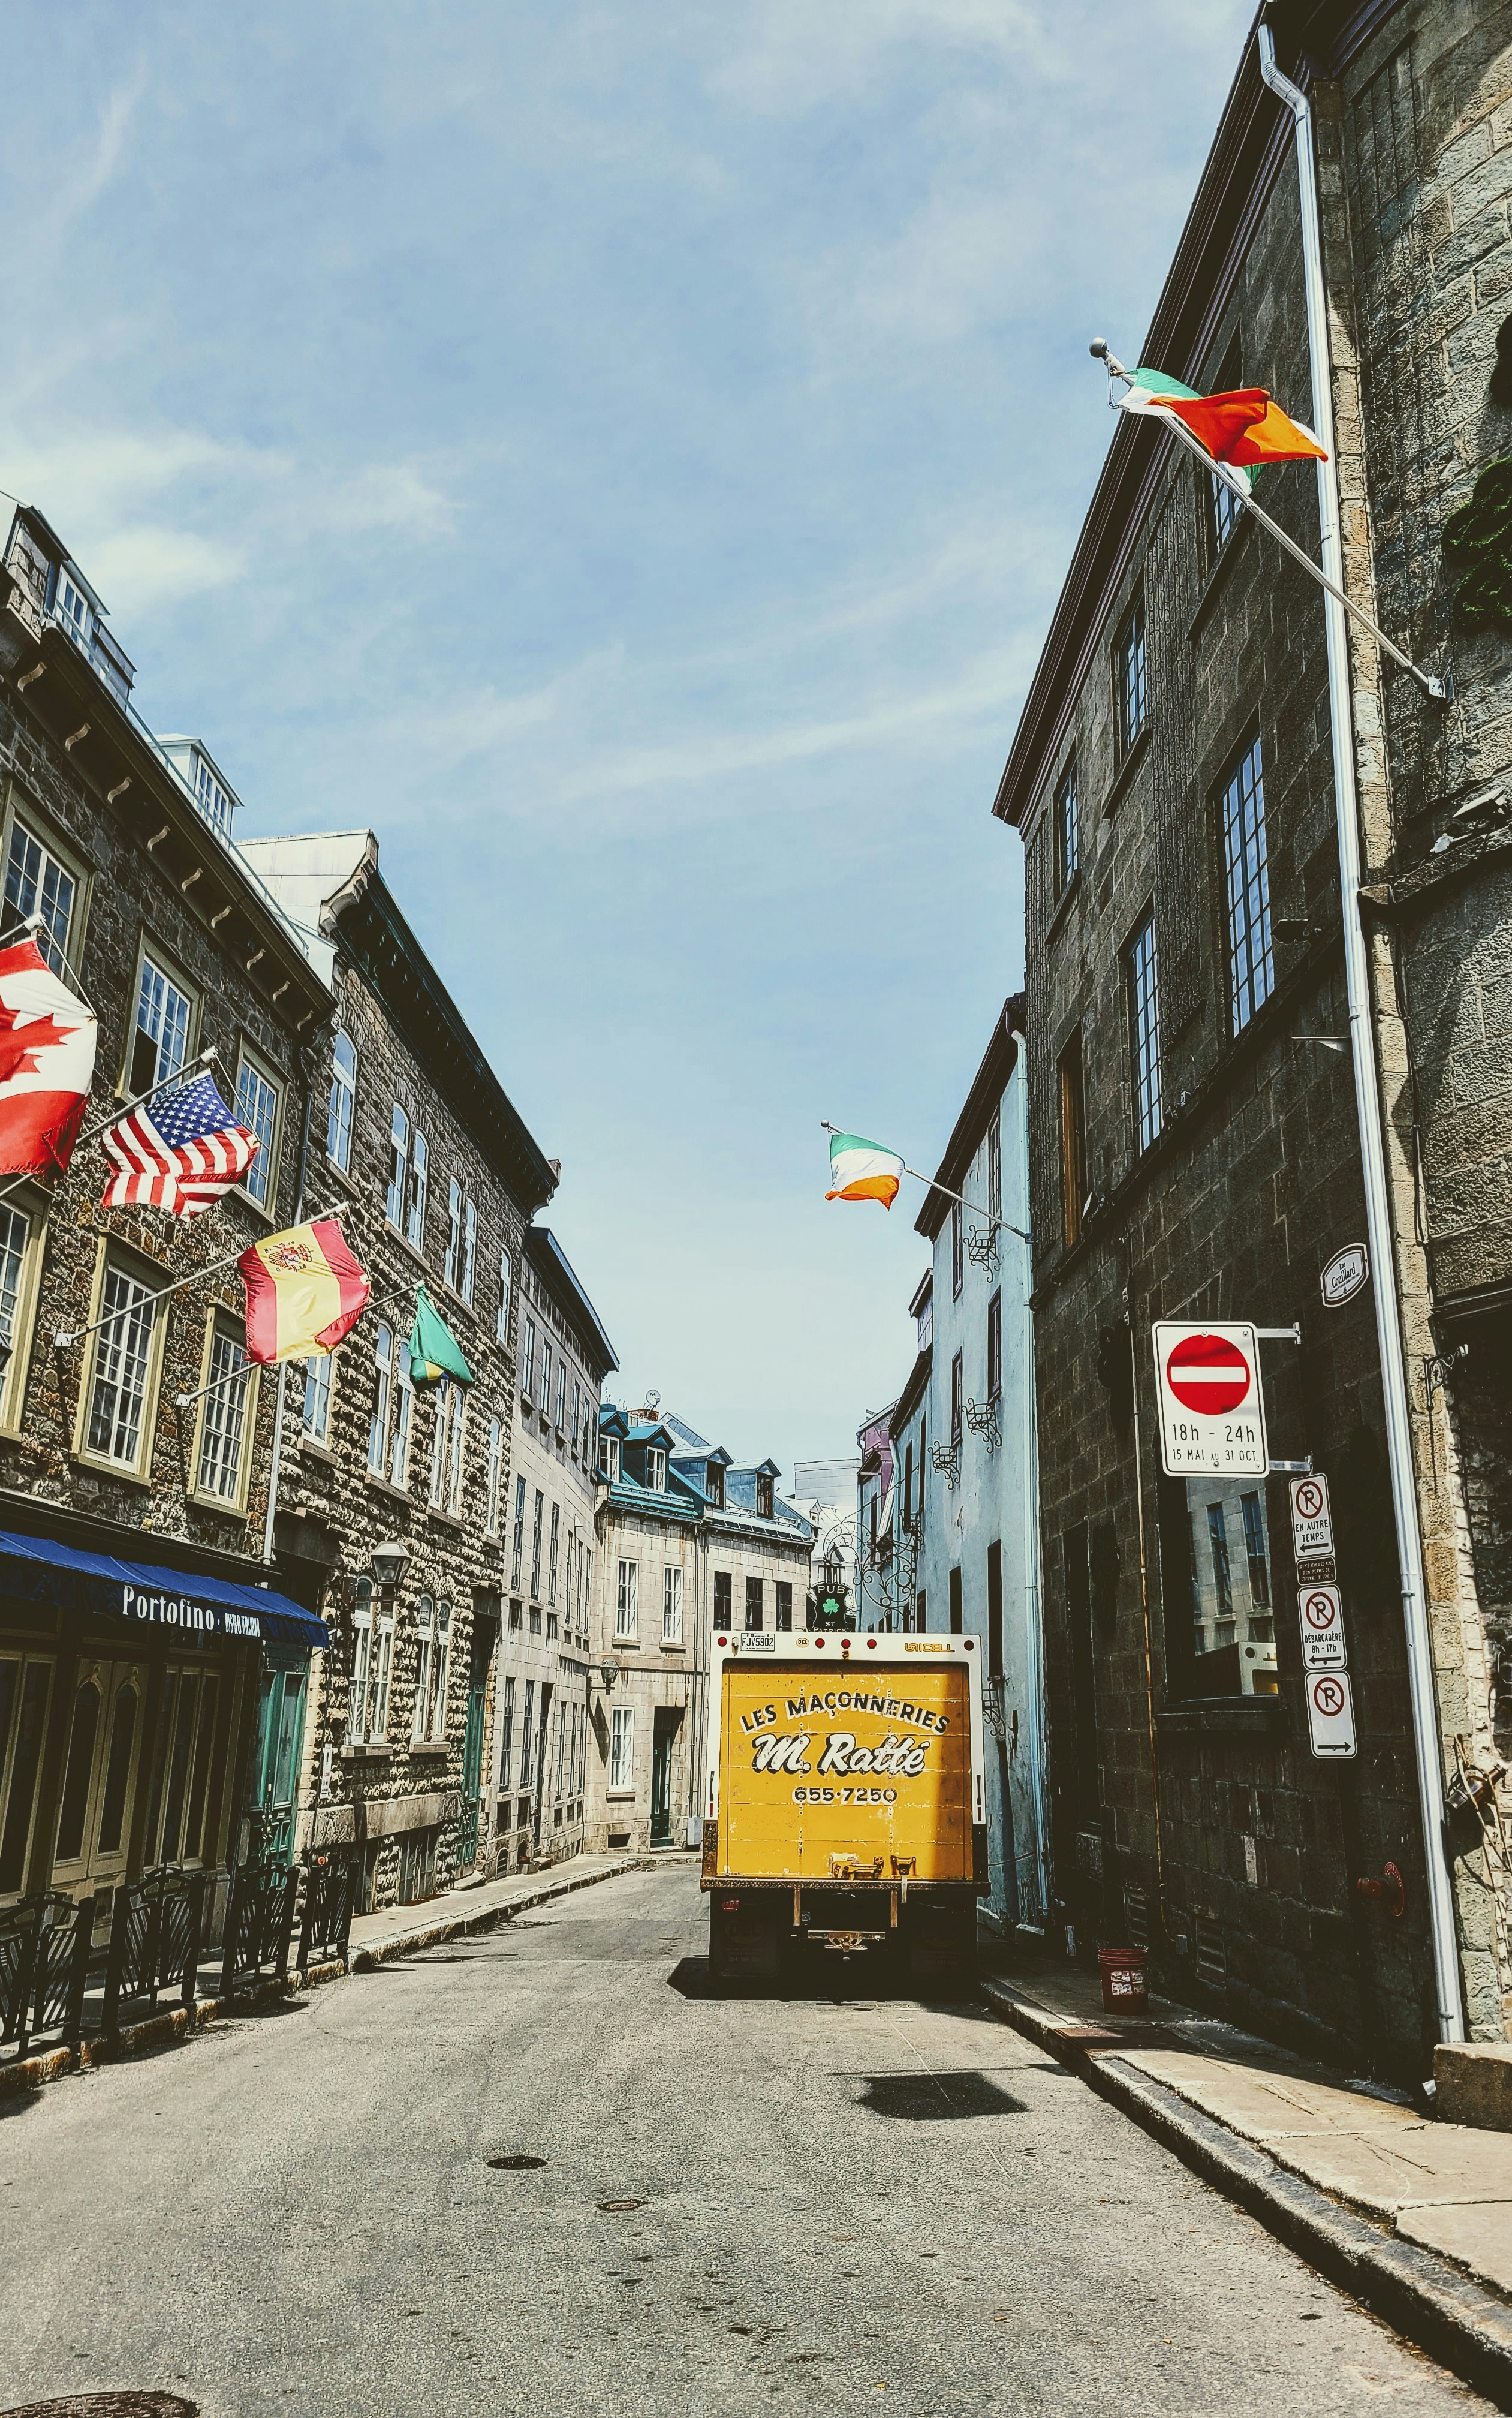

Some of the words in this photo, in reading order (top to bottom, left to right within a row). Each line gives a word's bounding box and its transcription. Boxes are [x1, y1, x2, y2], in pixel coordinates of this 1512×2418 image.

[1332, 1262, 1356, 1288] Couillard
[1172, 1424, 1199, 1441] 18h
[1225, 1425, 1255, 1442] 24h
[1173, 1449, 1182, 1460] 15
[1188, 1449, 1204, 1460] MAI
[1211, 1452, 1219, 1461] AU
[1225, 1449, 1234, 1461] 31
[1295, 1523, 1304, 1532] EN
[1306, 1519, 1329, 1530] AUTRE
[1302, 1532, 1324, 1542] TEMPS
[817, 1585, 845, 1594] PUB
[122, 1584, 215, 1631] Portofino
[742, 1637, 773, 1647] FJV5902
[1305, 1632, 1342, 1644] DÉBARCADÈRE
[905, 1643, 956, 1653] UNICELL
[1311, 1644, 1320, 1653] 8h
[1326, 1644, 1337, 1653] 17h
[740, 1704, 778, 1736] LES
[785, 1691, 951, 1736] MAÇONNERIES
[751, 1733, 811, 1774] M.
